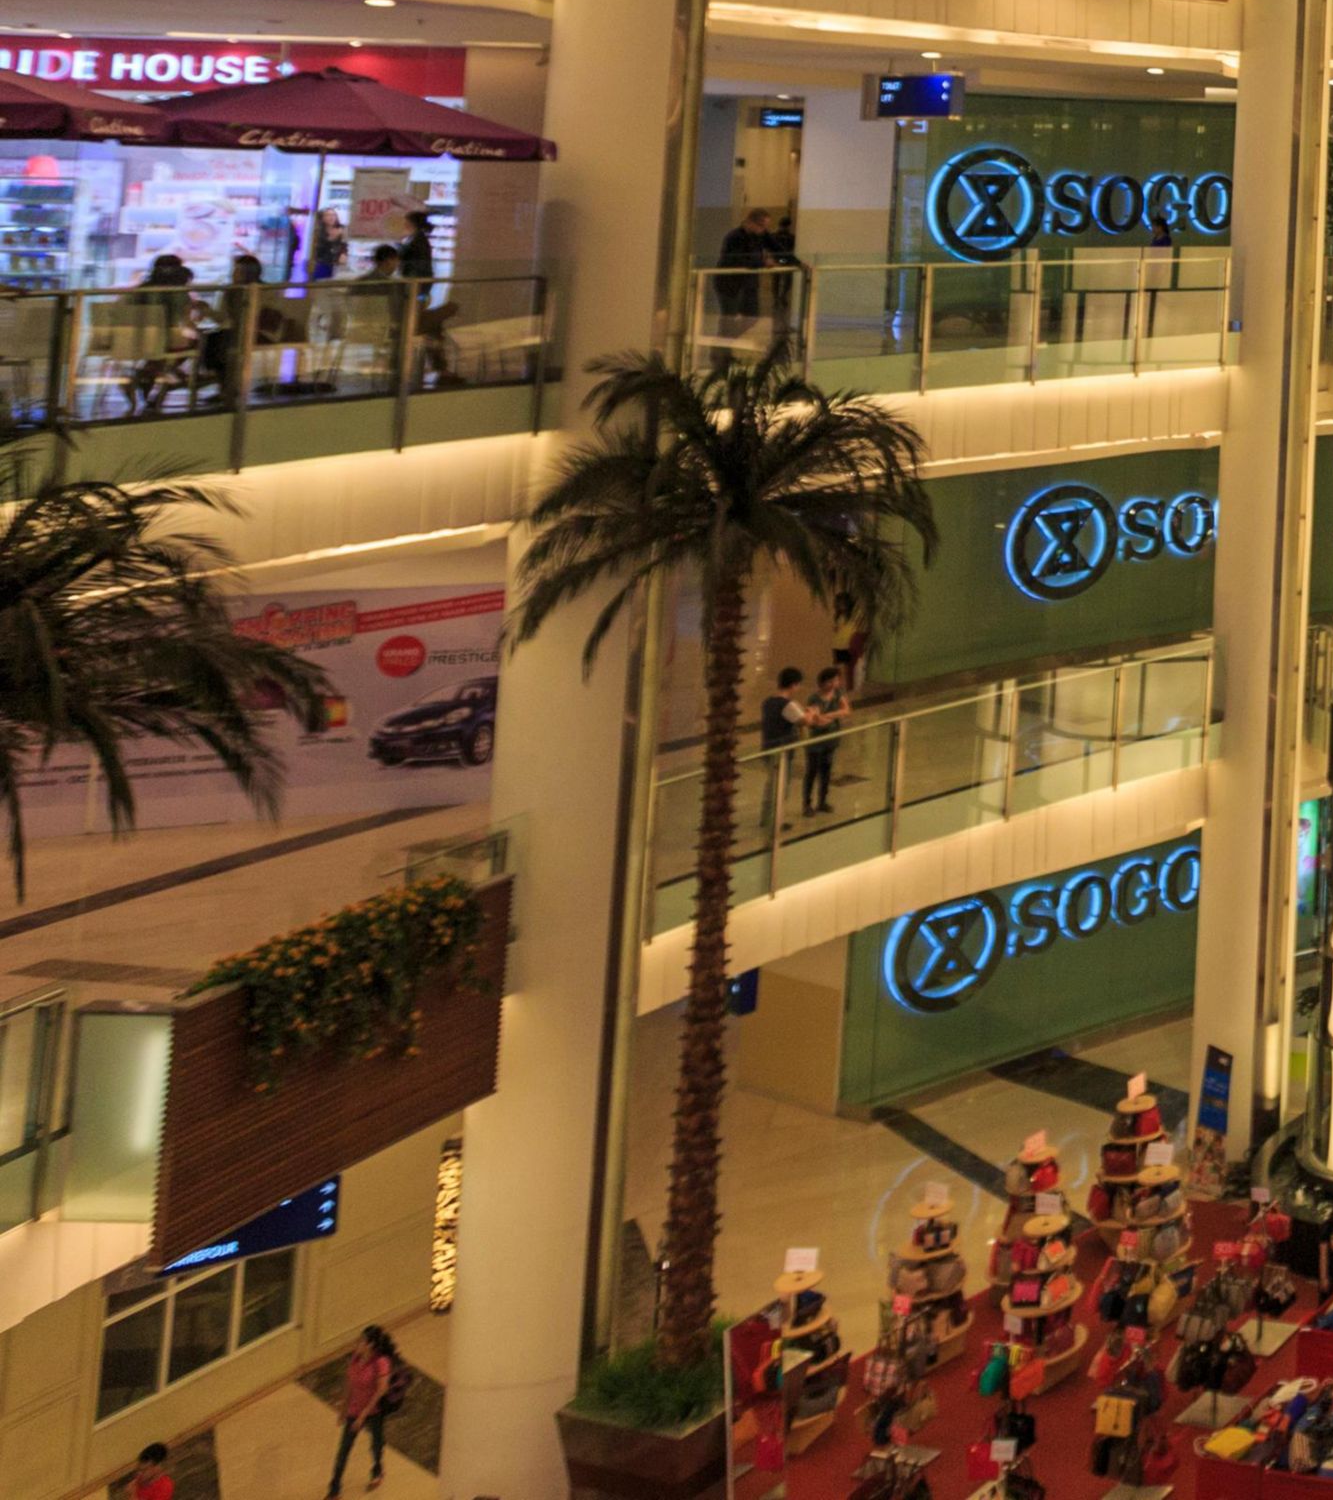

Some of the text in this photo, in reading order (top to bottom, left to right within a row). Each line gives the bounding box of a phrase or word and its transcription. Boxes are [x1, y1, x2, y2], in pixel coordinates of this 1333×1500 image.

[110, 52, 271, 84] HOUSE
[237, 129, 341, 150] Chatime
[430, 138, 505, 158] Chatime
[1044, 170, 1232, 236] SOGO
[1004, 844, 1200, 958] SOGO
